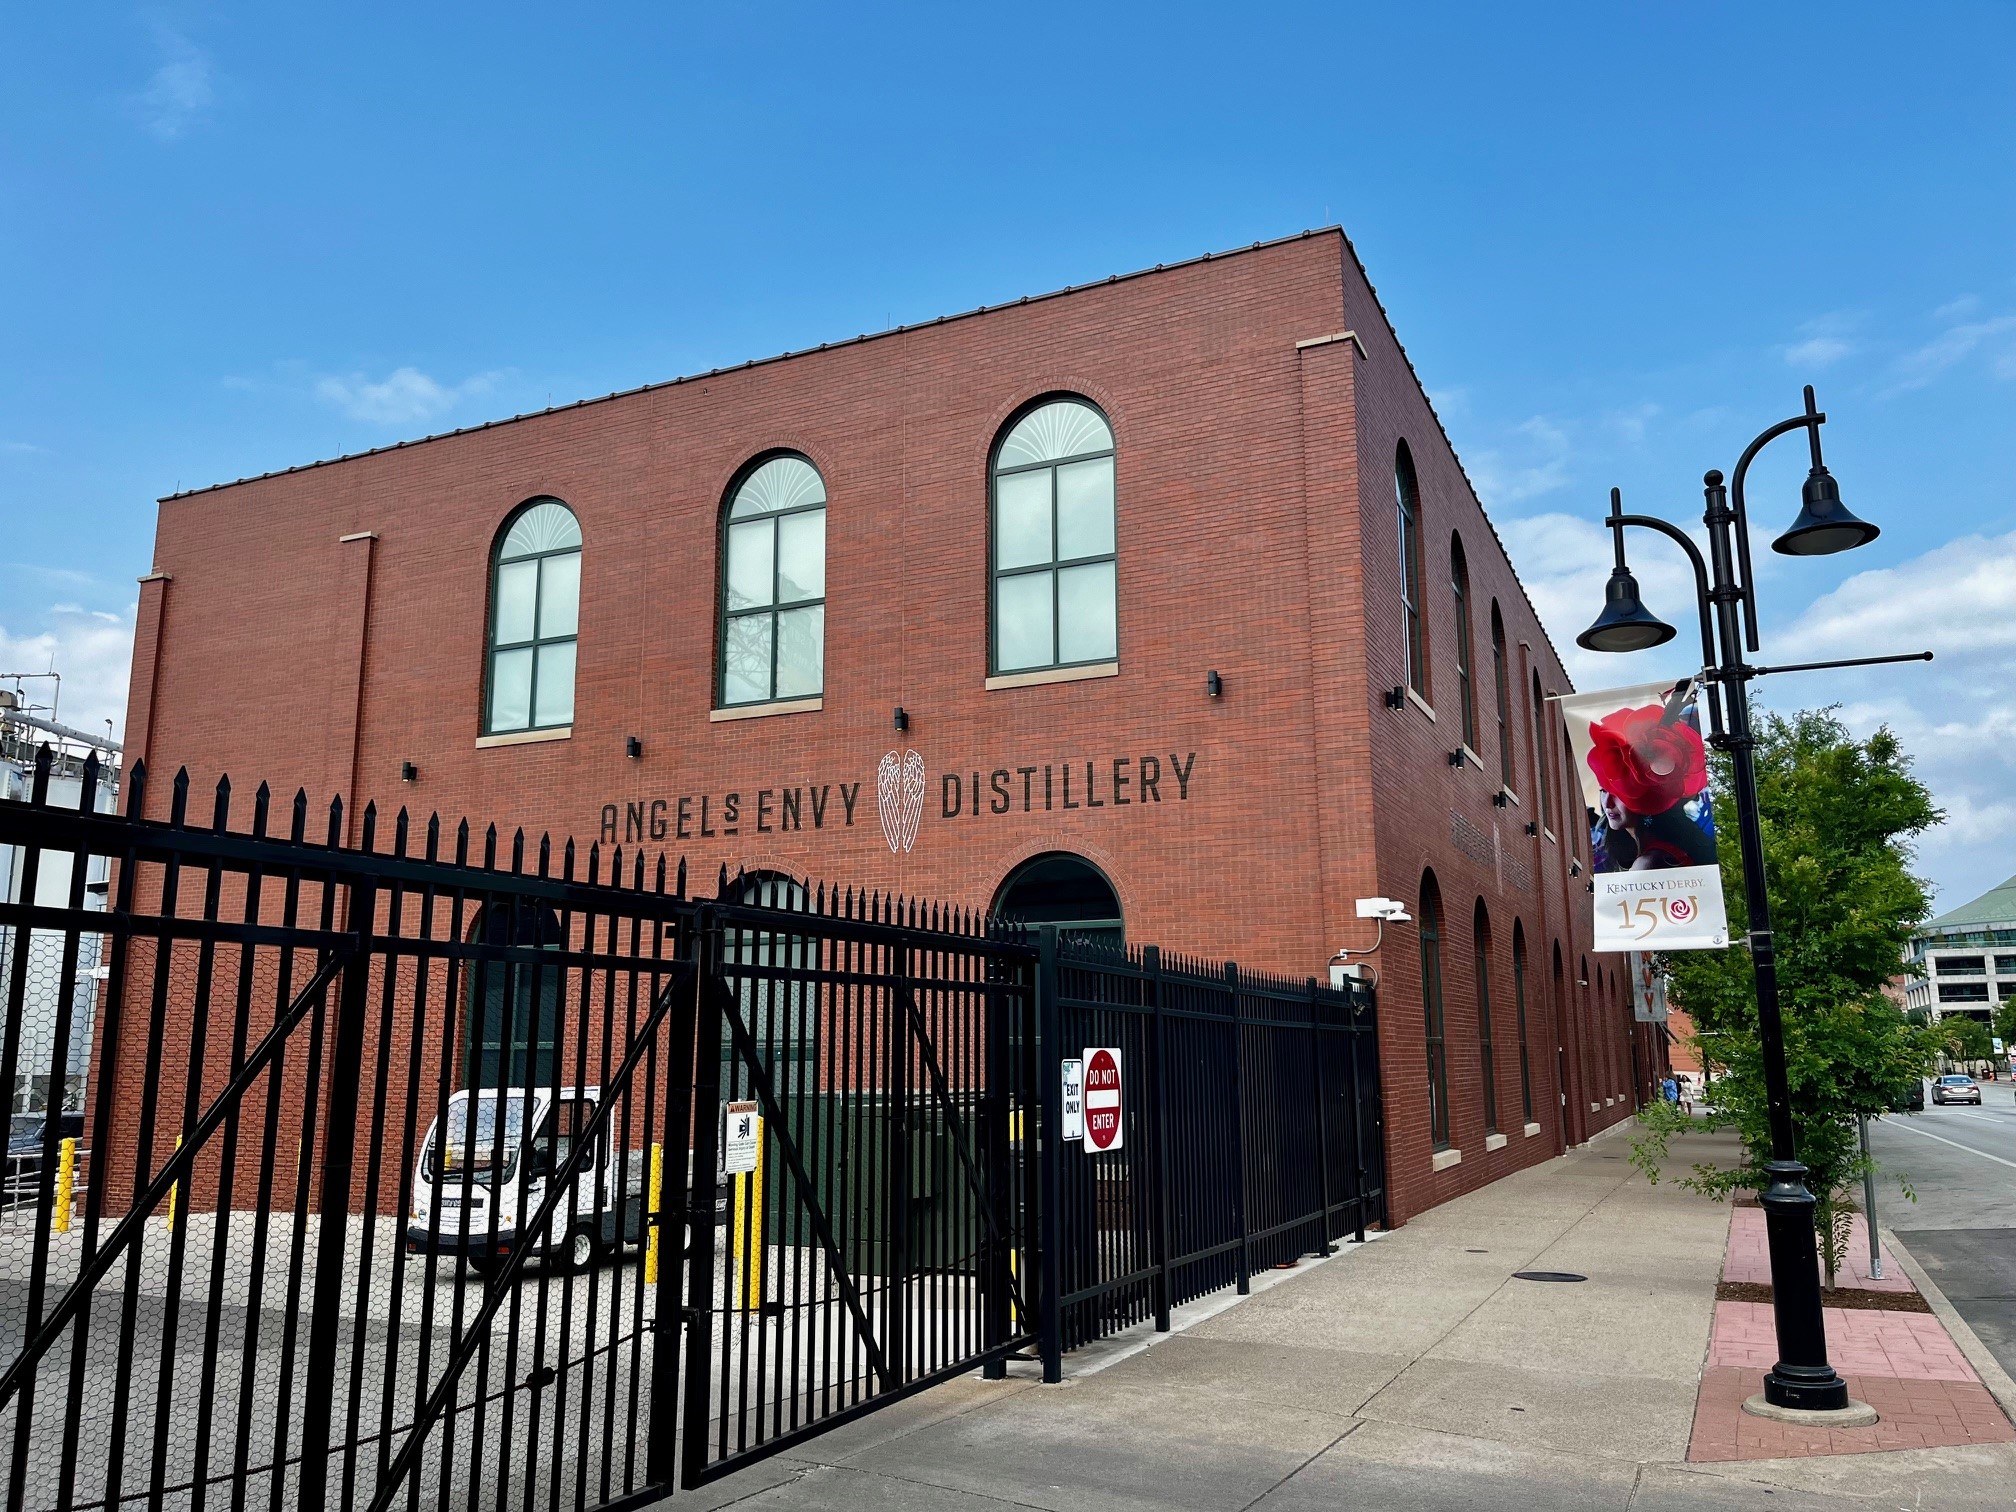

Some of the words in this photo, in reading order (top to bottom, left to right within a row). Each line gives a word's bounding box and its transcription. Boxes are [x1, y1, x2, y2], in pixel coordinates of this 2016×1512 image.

[757, 782, 862, 834] ENVY
[942, 752, 1197, 819] DISTILLERY
[1606, 881, 1665, 894] KENTUCKY
[1667, 878, 1704, 889] DERBY
[1089, 1069, 1099, 1085] DO
[1101, 1069, 1116, 1085] NOT
[1066, 1083, 1079, 1096] EXIT
[1065, 1100, 1080, 1114] ONLY
[1092, 1113, 1115, 1130] ENTER
